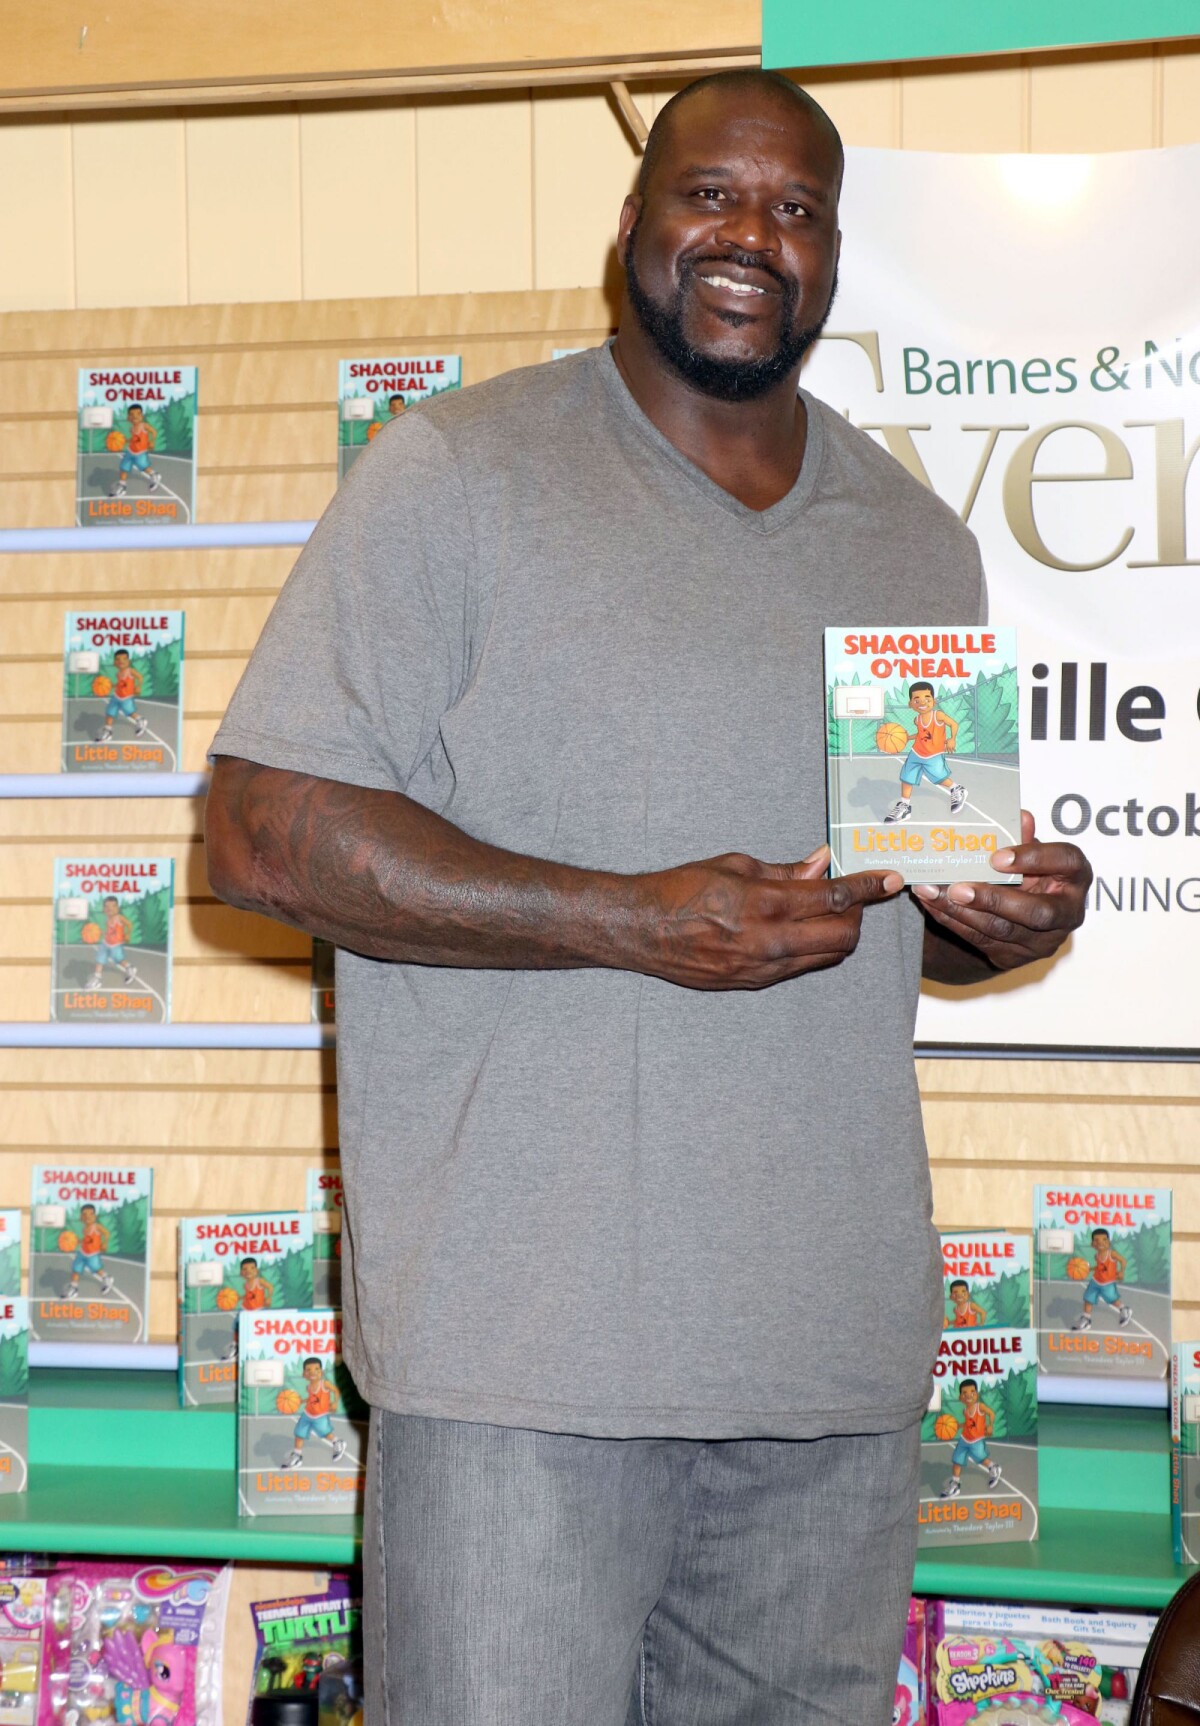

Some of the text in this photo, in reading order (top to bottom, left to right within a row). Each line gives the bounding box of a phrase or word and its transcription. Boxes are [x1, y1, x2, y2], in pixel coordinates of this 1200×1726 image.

[89, 370, 182, 386] SHAQUILLE
[350, 360, 445, 377] SHAQUILLE
[902, 346, 1079, 396] Barnes
[1090, 345, 1132, 393] &
[105, 387, 166, 402] O'NEAL
[366, 378, 428, 393] O'NEAL
[88, 500, 177, 518] Little Shaq
[76, 616, 169, 631] SHAQUILLE
[92, 633, 152, 647] O'NEAL
[844, 633, 997, 656] SHAQUILLE
[870, 657, 972, 679] O'NEAL
[1018, 662, 1166, 743] ille
[74, 745, 164, 764] Little Shaq
[852, 827, 998, 853] Little Shaq
[902, 854, 944, 865] Theodore
[945, 854, 973, 867] Taylor
[974, 854, 987, 864] III
[65, 863, 158, 878] SHAQUILLE
[80, 879, 141, 893] O'NEAL
[63, 992, 154, 1011] Little Shaq
[43, 1170, 136, 1185] SHAQUILLE
[58, 1186, 119, 1202] O'NEAL
[1045, 1190, 1156, 1210] SHAQUILLE
[1064, 1209, 1137, 1228] O'NEAL
[195, 1220, 301, 1240] SHAQUILLE
[214, 1239, 283, 1256] O'NEAL
[942, 1242, 1015, 1260] QUILLE
[943, 1261, 996, 1277] NEAL
[40, 1301, 130, 1324] Little Shaq
[253, 1318, 342, 1337] SHAQUI
[273, 1338, 342, 1356] O'NEA
[938, 1336, 1023, 1358] AQUILLE
[1047, 1332, 1153, 1359] Little Shaq
[198, 1363, 237, 1384] Littl
[932, 1357, 1005, 1378] O'NEAL
[256, 1471, 312, 1493] Little
[917, 1498, 1023, 1524] Little Shaq
[1041, 1615, 1061, 1624] Bath
[1063, 1616, 1086, 1625] Book
[951, 1665, 1015, 1694] Shopkins
